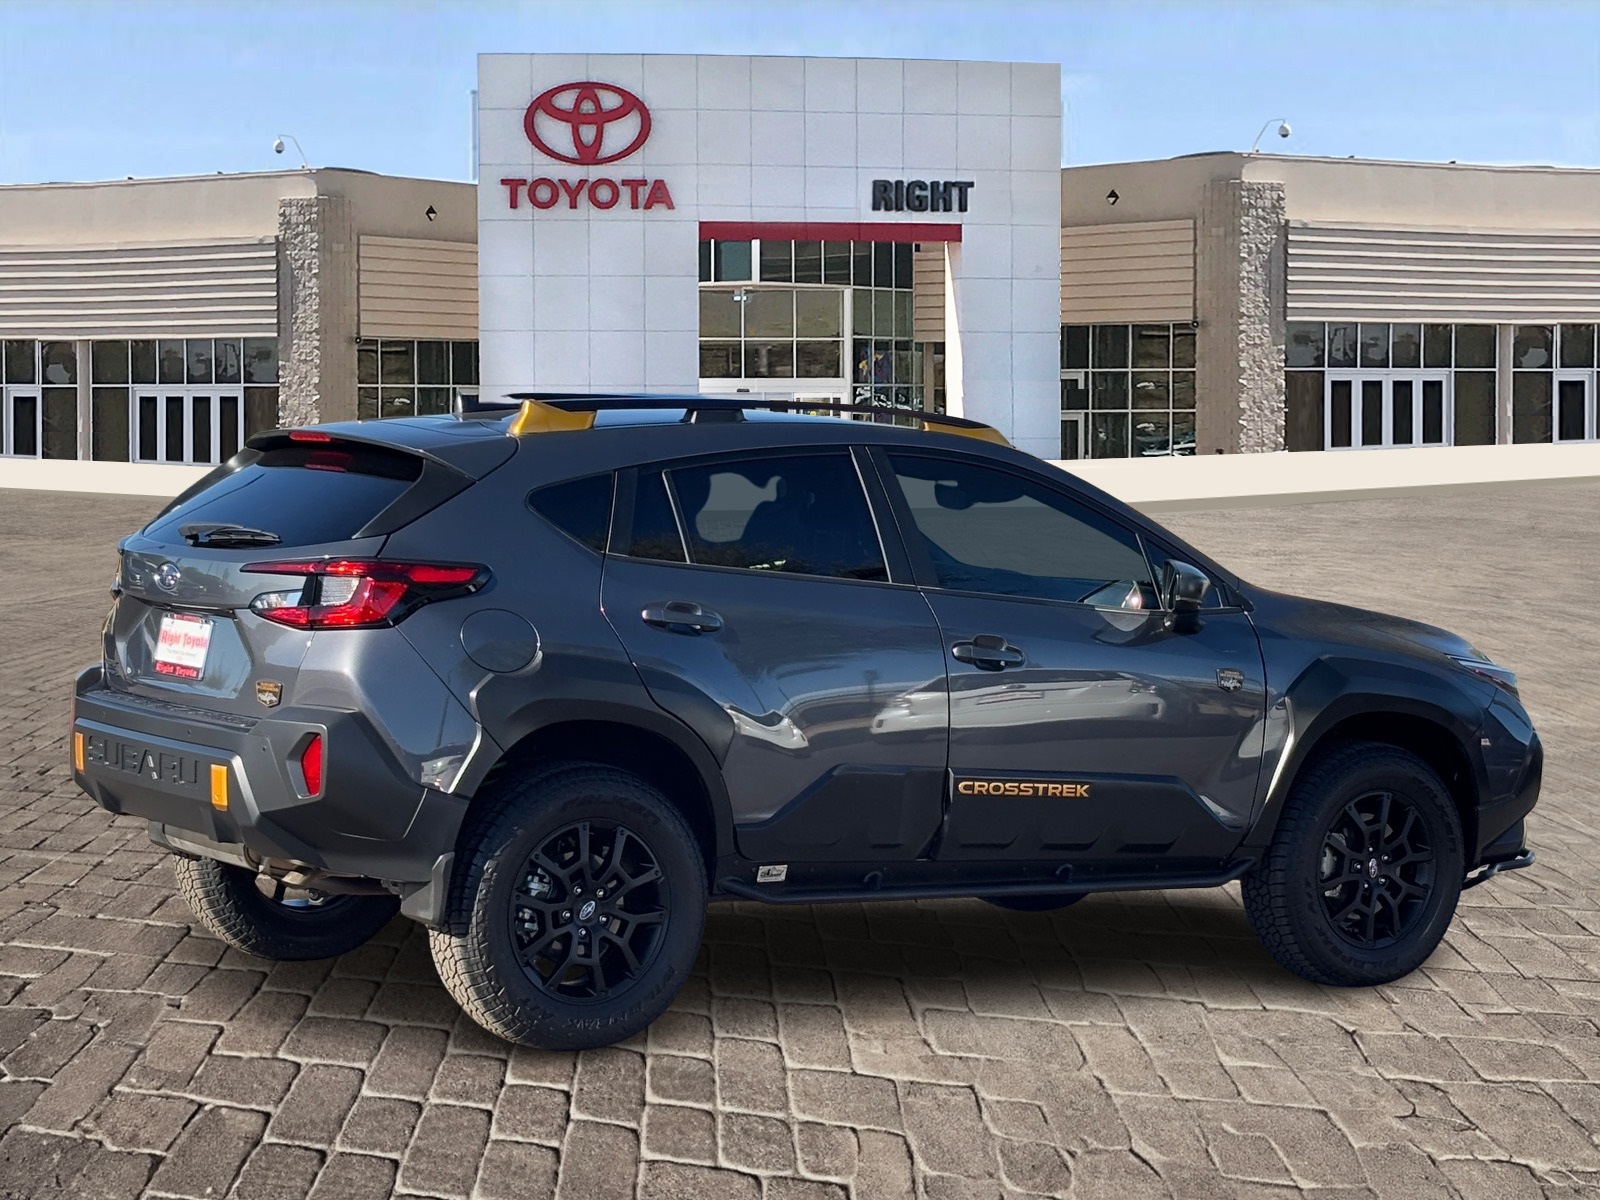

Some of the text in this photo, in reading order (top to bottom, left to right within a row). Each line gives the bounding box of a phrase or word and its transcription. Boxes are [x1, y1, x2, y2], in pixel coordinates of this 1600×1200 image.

[500, 177, 675, 210] TOYOTA
[872, 179, 974, 212] RIGHT
[161, 630, 208, 649] Right Toyota
[88, 734, 199, 785] SUBARU
[958, 780, 1090, 798] CROSSTREK
